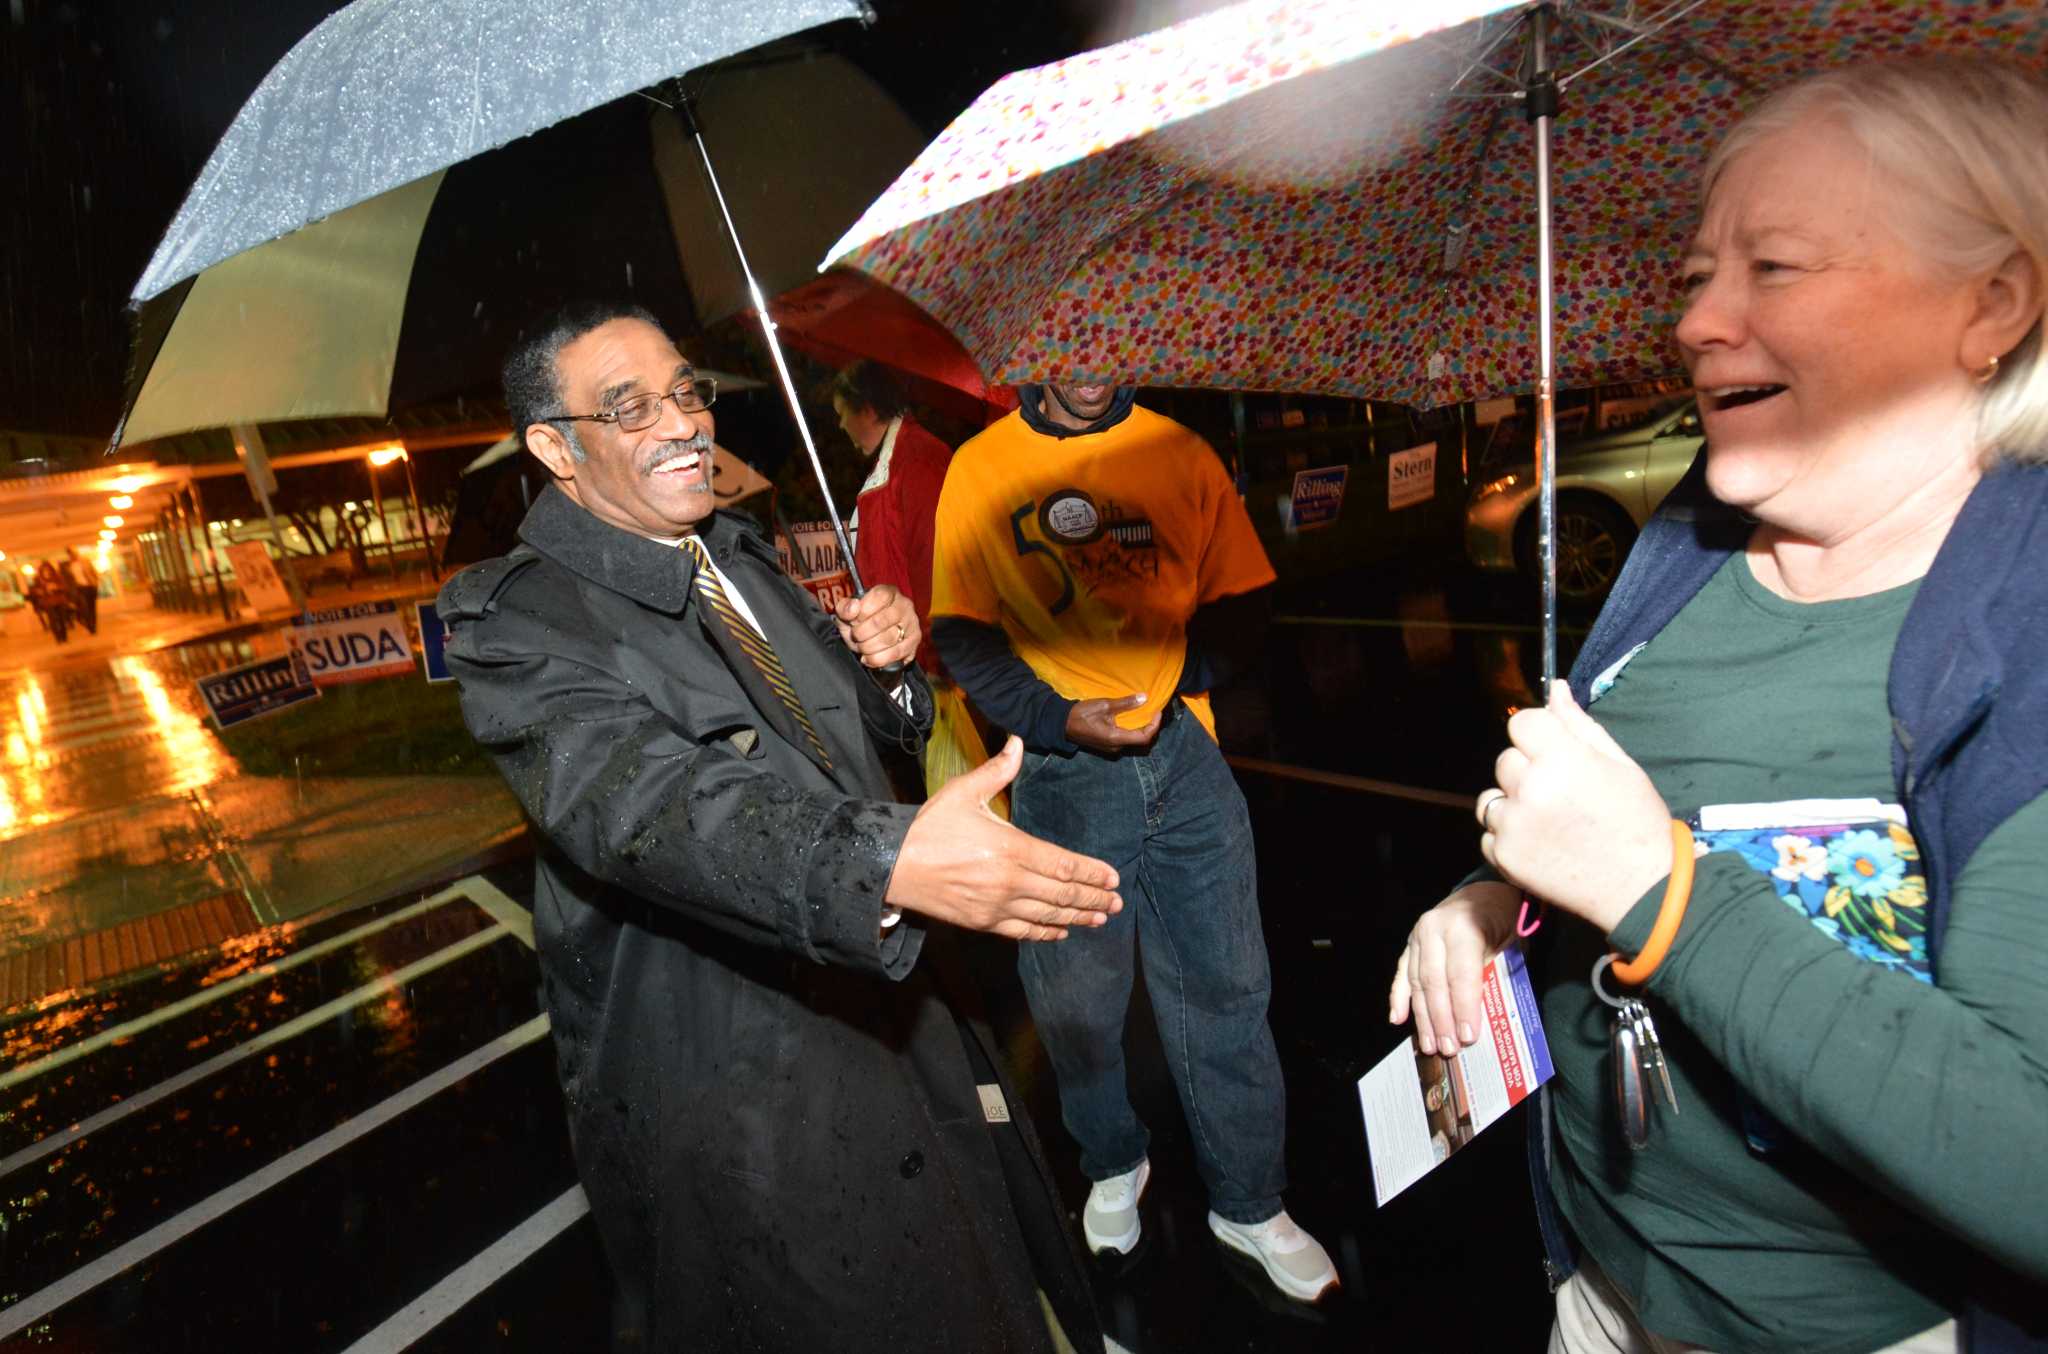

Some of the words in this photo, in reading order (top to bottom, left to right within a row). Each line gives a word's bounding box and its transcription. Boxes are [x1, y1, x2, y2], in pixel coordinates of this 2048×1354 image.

[1393, 457, 1432, 480] Stern
[1297, 477, 1342, 499] Rilling
[305, 628, 406, 671] SUDA
